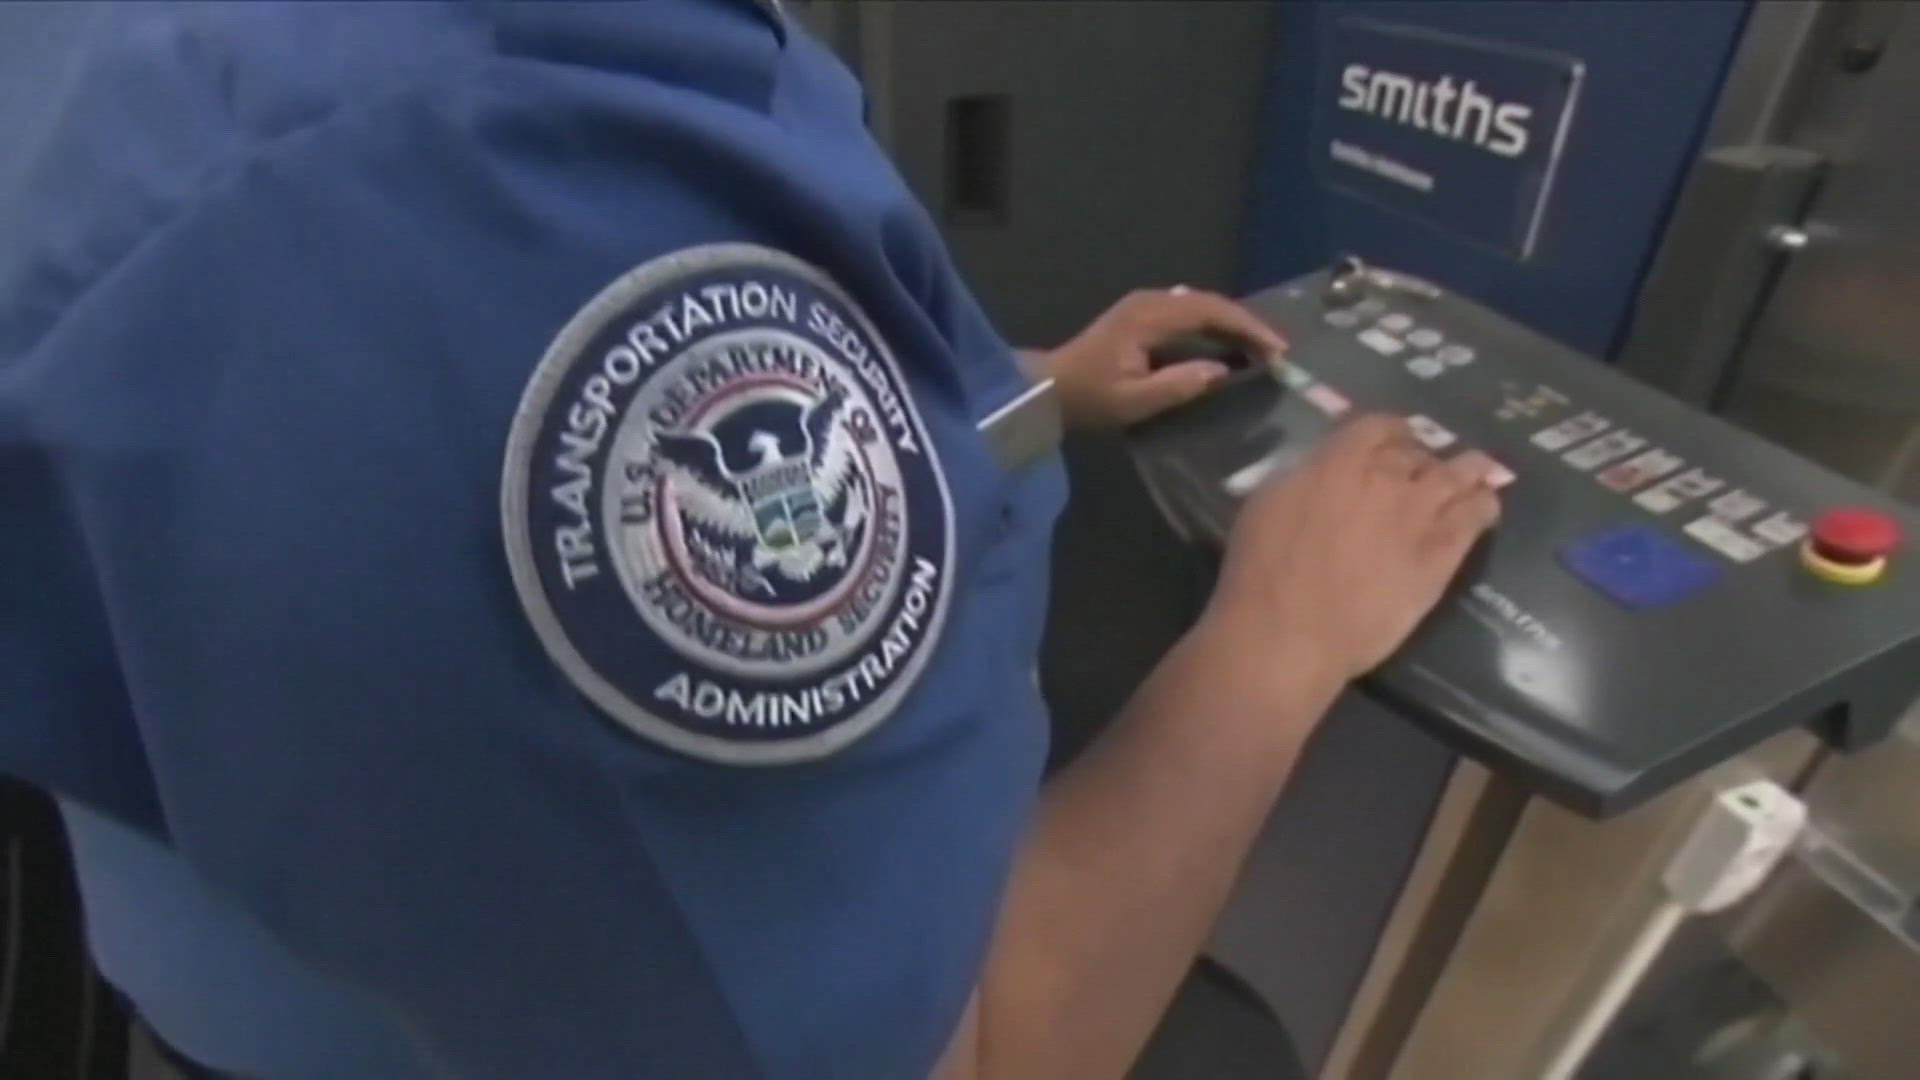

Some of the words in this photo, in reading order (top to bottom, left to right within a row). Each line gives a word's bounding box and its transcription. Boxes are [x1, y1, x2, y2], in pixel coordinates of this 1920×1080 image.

[1338, 62, 1532, 157] smiths
[551, 281, 797, 591] TRANSPORTATION
[807, 301, 920, 454] SECURITY
[644, 570, 830, 663] HOMELAND
[653, 557, 938, 727] ADMINISTRATION
